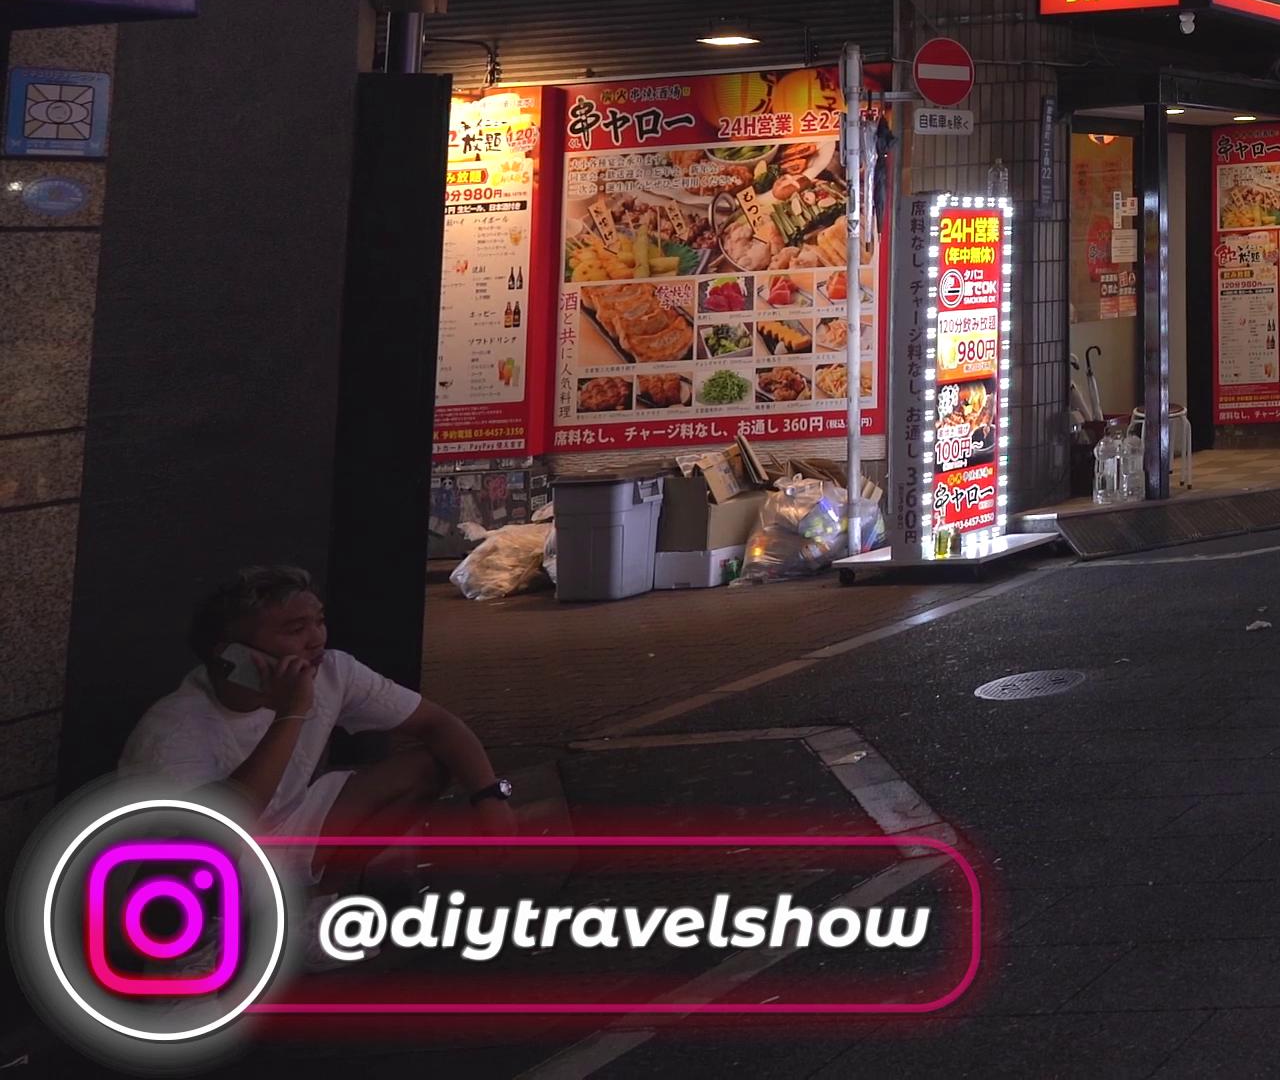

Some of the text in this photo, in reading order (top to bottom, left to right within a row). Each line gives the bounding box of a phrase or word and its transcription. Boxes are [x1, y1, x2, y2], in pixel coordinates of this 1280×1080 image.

[568, 96, 694, 149] 串ヤロー
[718, 112, 793, 138] 24H営業
[919, 113, 970, 131] 自転車を除く
[939, 216, 1000, 244] 24H営業
[944, 246, 995, 265] (年中無休)
[939, 315, 996, 334] 120分飲み放題
[957, 339, 996, 363] 980円
[553, 416, 824, 446] 席料なし、 チャージ料なし、 お通し 360円
